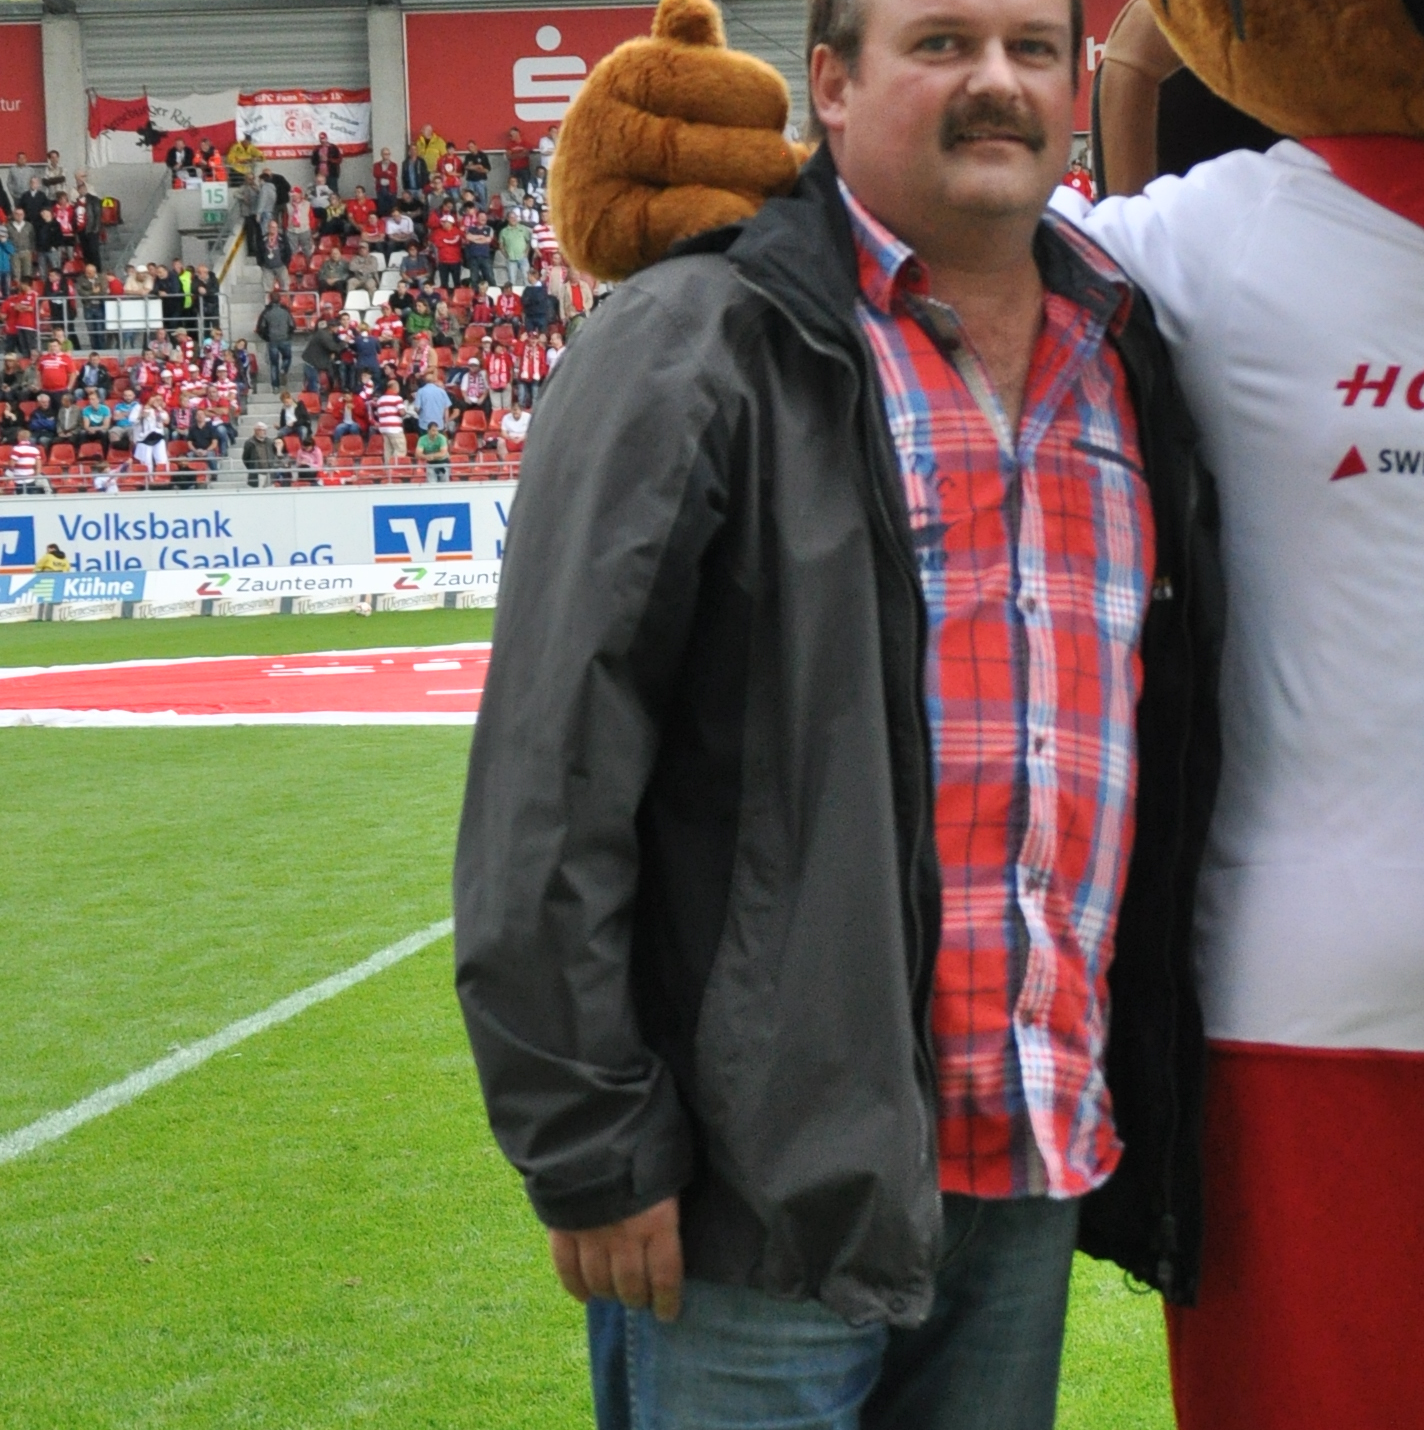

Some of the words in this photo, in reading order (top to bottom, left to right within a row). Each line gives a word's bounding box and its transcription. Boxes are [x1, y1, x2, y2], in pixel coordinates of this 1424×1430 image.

[205, 188, 225, 205] 15
[58, 510, 233, 541] Volksbank
[159, 543, 273, 570] (Saale)
[289, 543, 334, 566] eG
[63, 576, 135, 597] Kühne
[236, 576, 353, 593] Zaunteam
